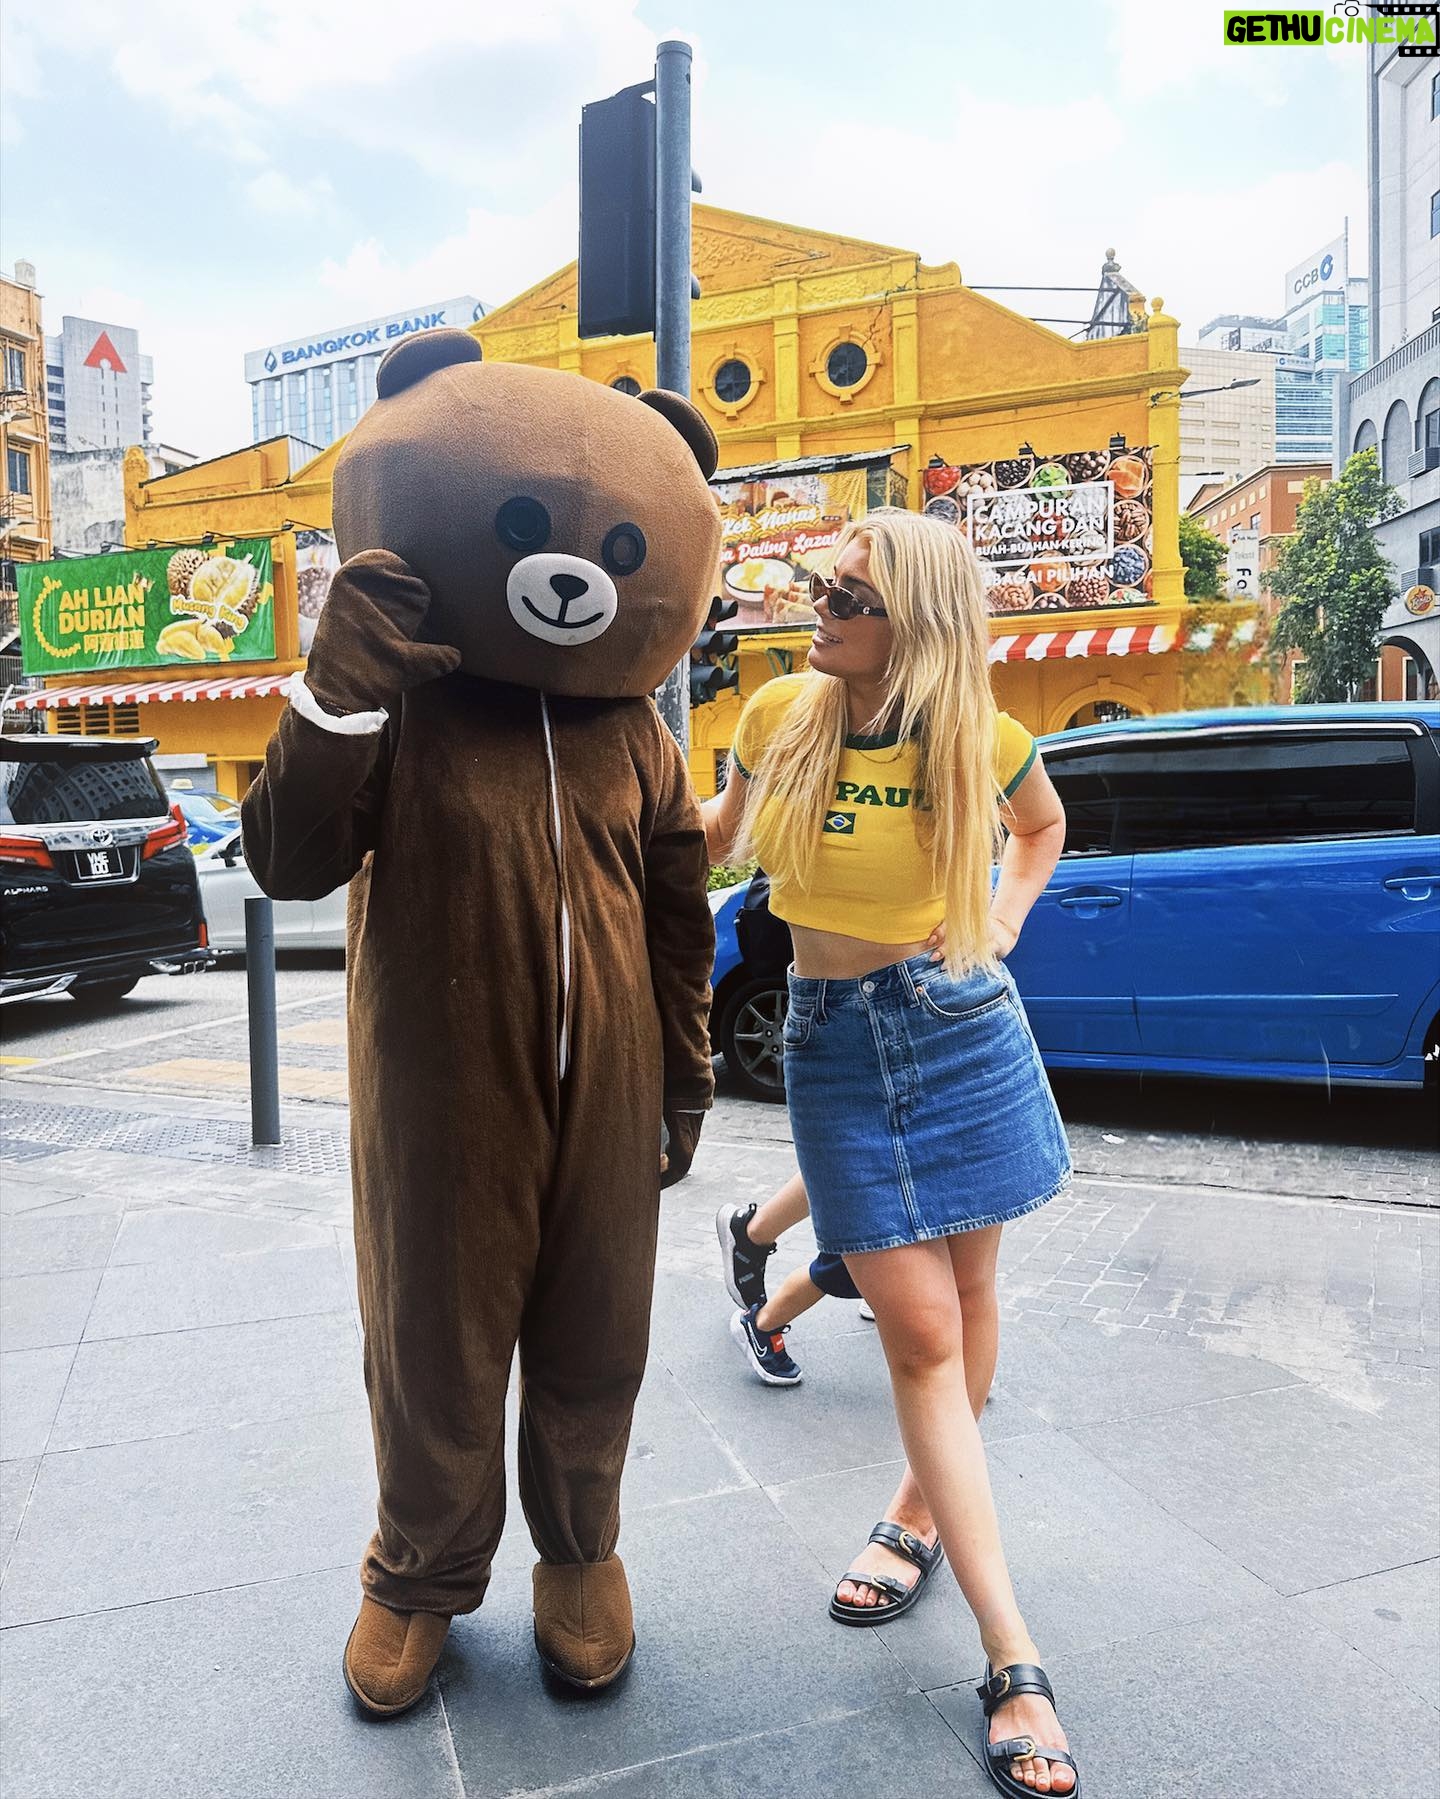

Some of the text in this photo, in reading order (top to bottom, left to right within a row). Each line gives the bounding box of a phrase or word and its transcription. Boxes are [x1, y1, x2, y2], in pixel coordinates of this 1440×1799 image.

[1294, 268, 1319, 294] CCB
[281, 310, 447, 365] BANGKOK BANK
[974, 497, 1105, 524] CAMPURAN
[975, 516, 1105, 541] KACANG DAN
[738, 539, 789, 561] Paling
[1047, 564, 1115, 583] PILIHAN
[59, 584, 145, 611] AH LIAN
[59, 605, 146, 634] DURIAN
